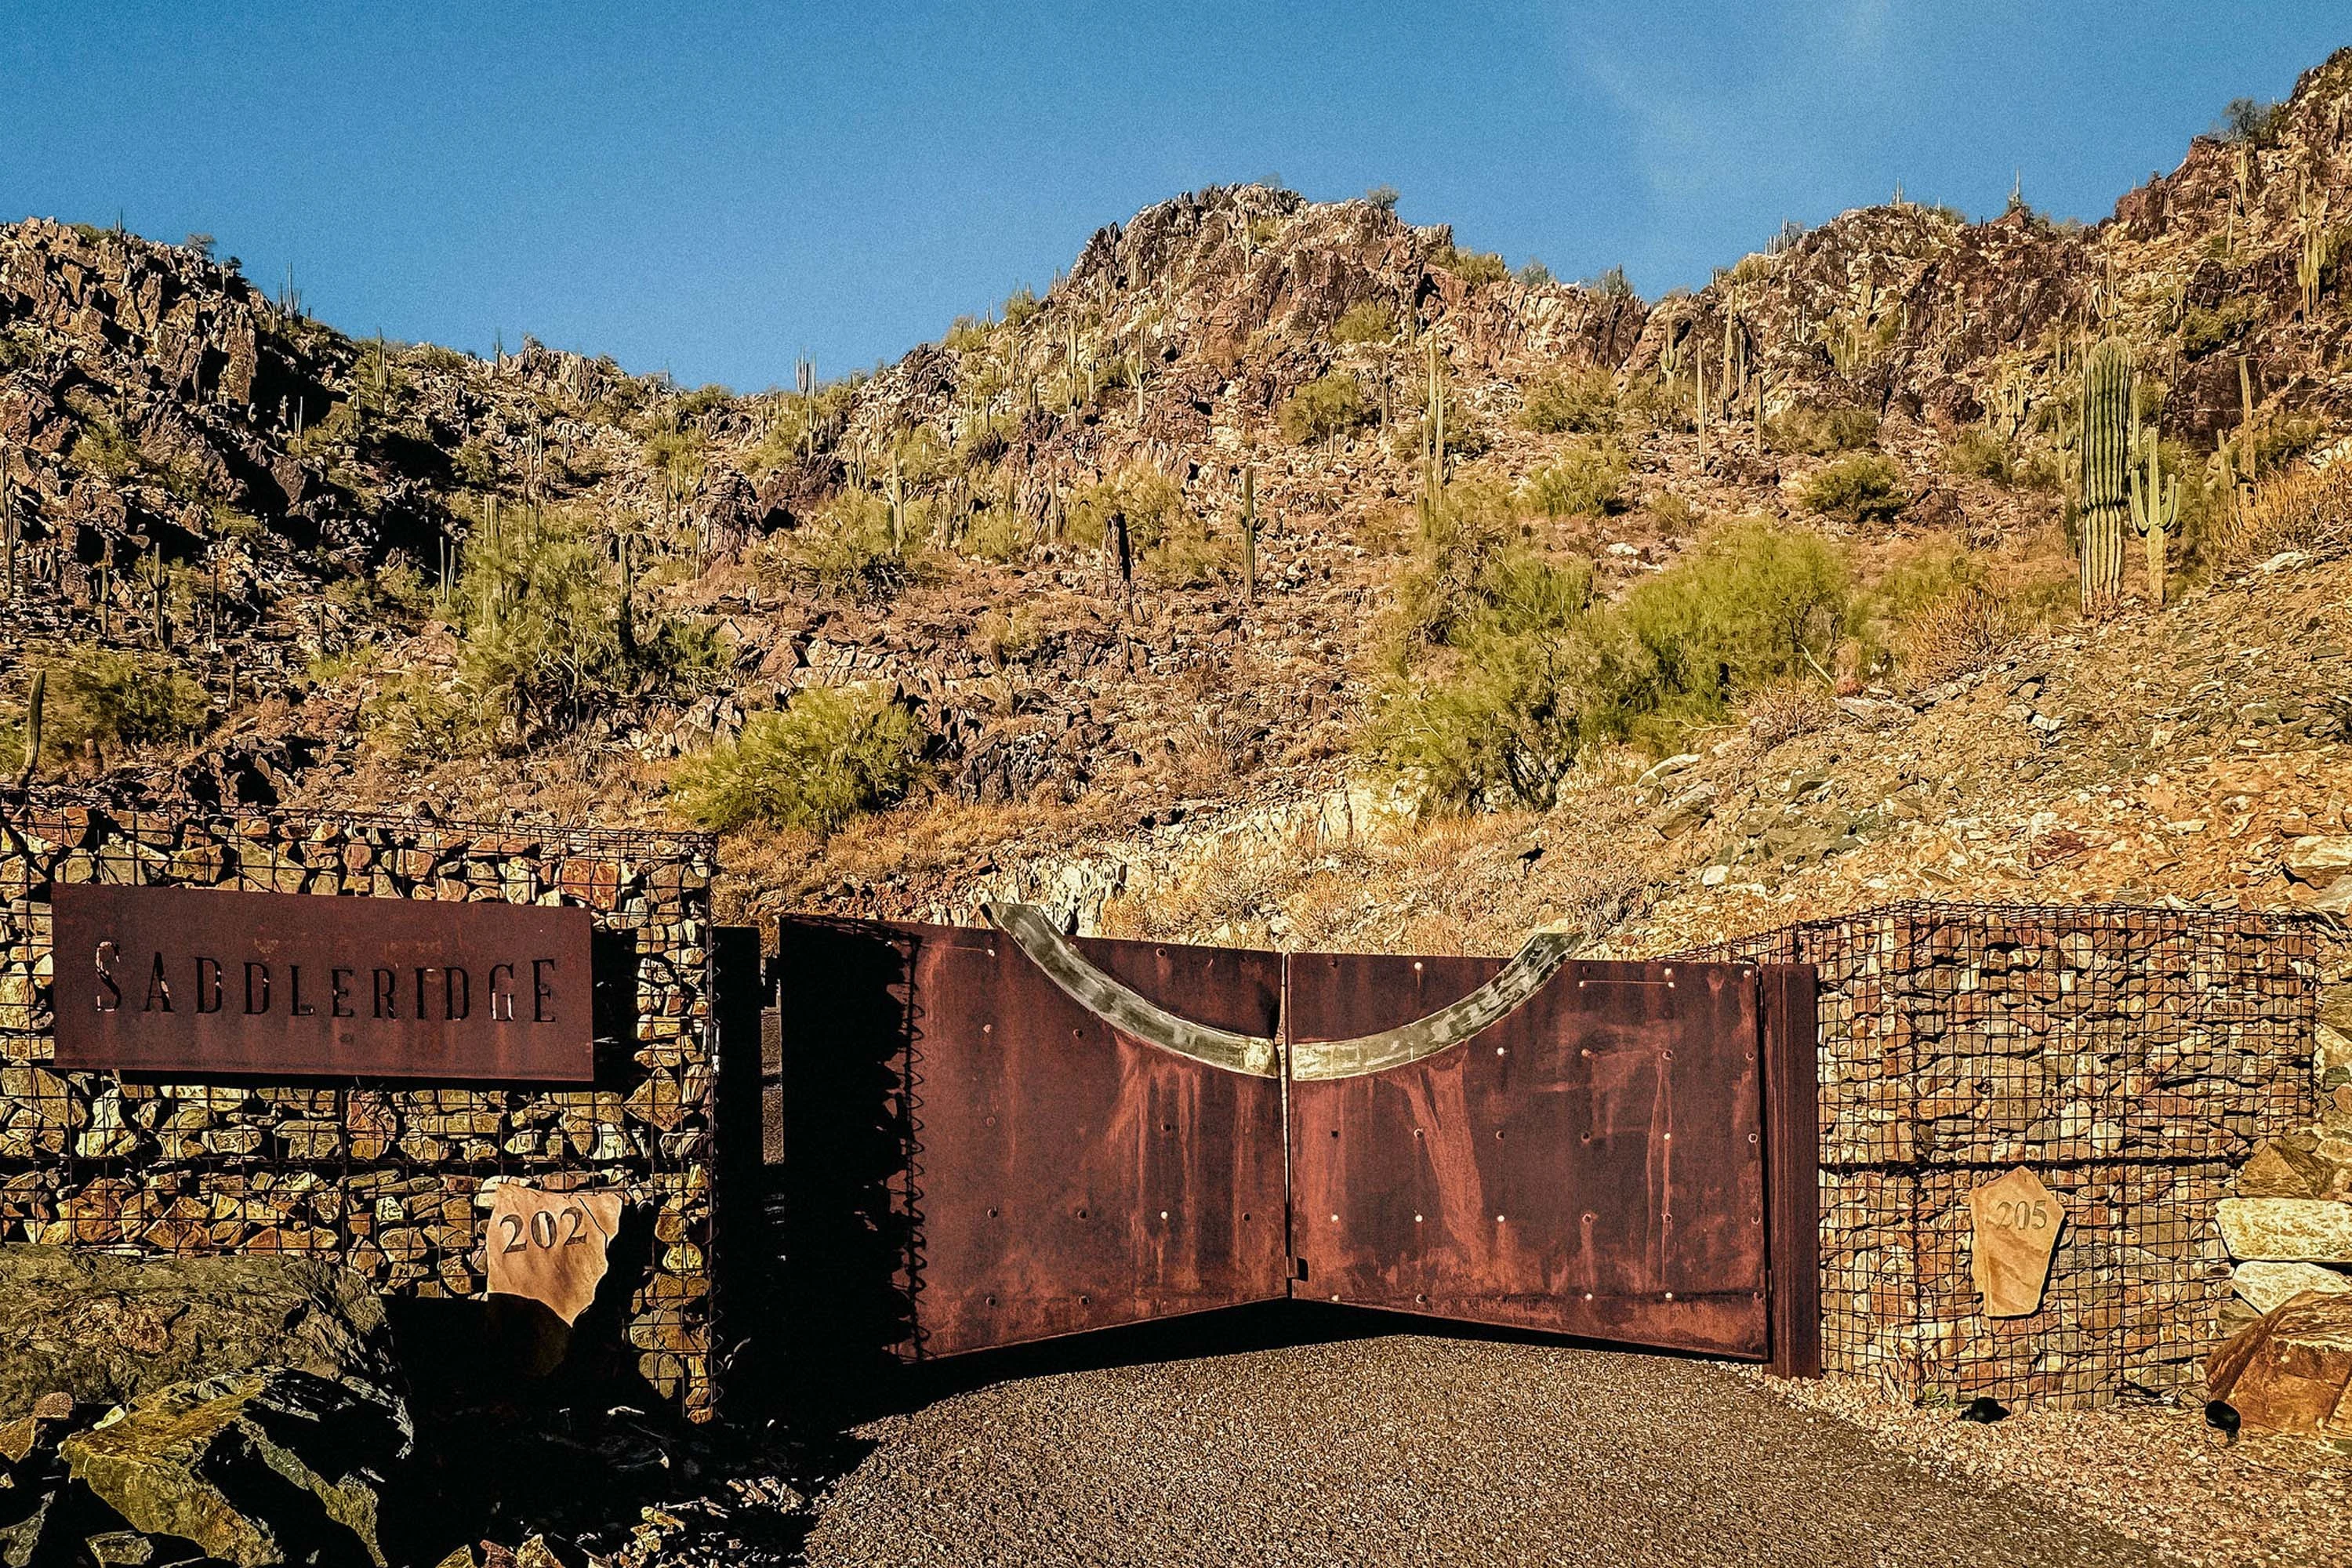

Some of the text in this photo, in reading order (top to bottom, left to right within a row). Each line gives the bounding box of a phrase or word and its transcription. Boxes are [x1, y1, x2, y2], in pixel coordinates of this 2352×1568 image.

[95, 941, 557, 1024] SADDLERIDGE
[499, 1207, 587, 1254] 202
[1996, 1200, 2048, 1231] 205
